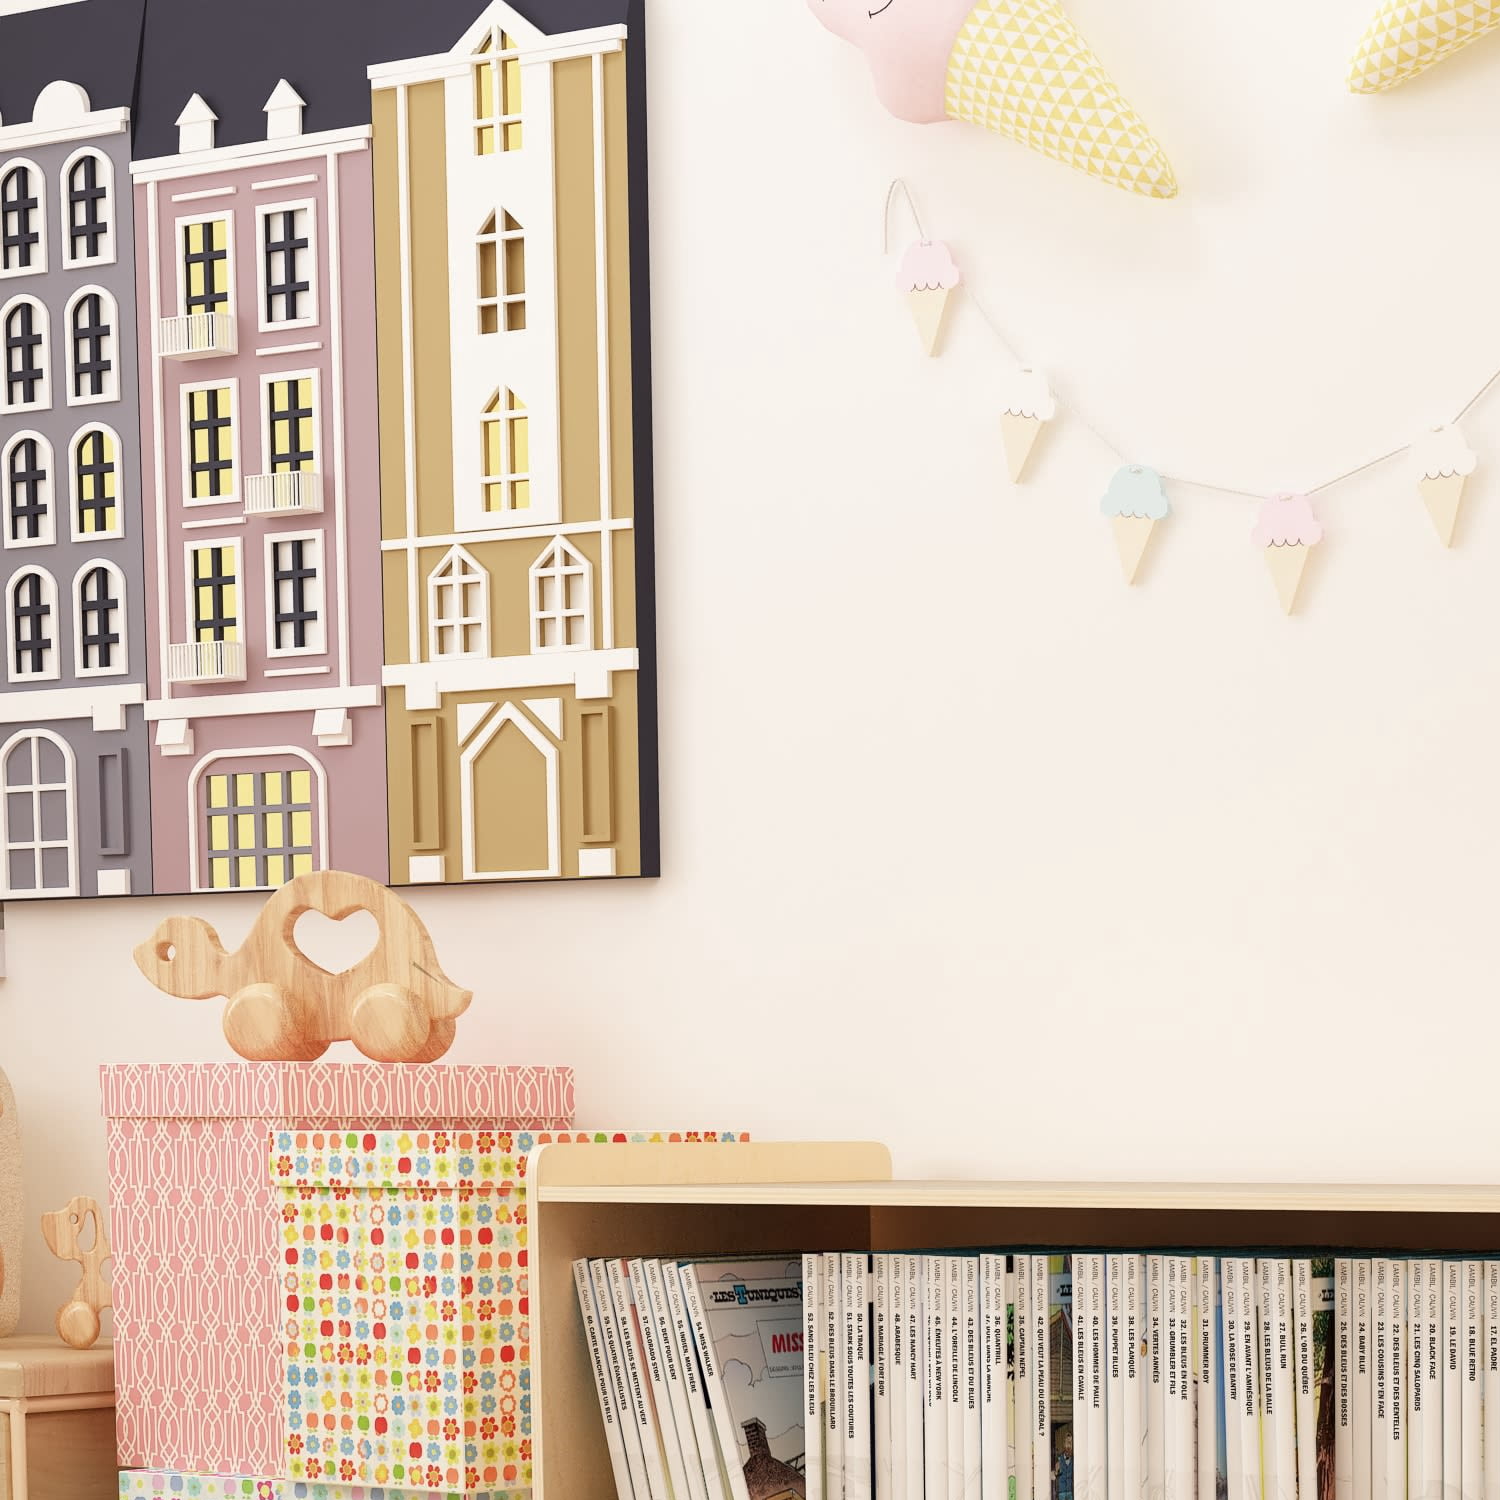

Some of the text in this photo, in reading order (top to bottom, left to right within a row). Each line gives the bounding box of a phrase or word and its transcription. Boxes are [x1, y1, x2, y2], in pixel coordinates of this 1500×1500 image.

[966, 1260, 974, 1283] LAMBIL
[1413, 1262, 1421, 1288] LAMBIL
[713, 1284, 799, 1305] LES TUNIQUES
[1413, 1293, 1421, 1318] CAUVIN
[1244, 1333, 1251, 1344] EN
[1468, 1325, 1476, 1337] 18.
[625, 1339, 635, 1362] BLEUS
[695, 1321, 714, 1377] 54. MISS WALKER
[1300, 1335, 1308, 1353] L'OR
[1468, 1338, 1476, 1357] BLUE
[629, 1361, 636, 1371] SE
[1127, 1342, 1135, 1379] PLANQUÉS
[1301, 1353, 1308, 1365] DU
[1377, 1348, 1385, 1381] COUSINS
[968, 1367, 974, 1375] ET
[1152, 1355, 1160, 1384] ANNÉES
[599, 1377, 607, 1396] POUR
[631, 1370, 642, 1399] METTENT
[829, 1378, 835, 1388] LE
[968, 1375, 974, 1386] DU
[1093, 1374, 1099, 1384] DE
[1301, 1365, 1309, 1395] QUÉBEC
[1245, 1367, 1253, 1416] L'AMNÉSIQUE
[1377, 1381, 1385, 1399] D'EN
[602, 1395, 609, 1407] UN
[637, 1399, 644, 1409] AU
[604, 1406, 613, 1424] BLEU
[639, 1408, 647, 1425] VERT
